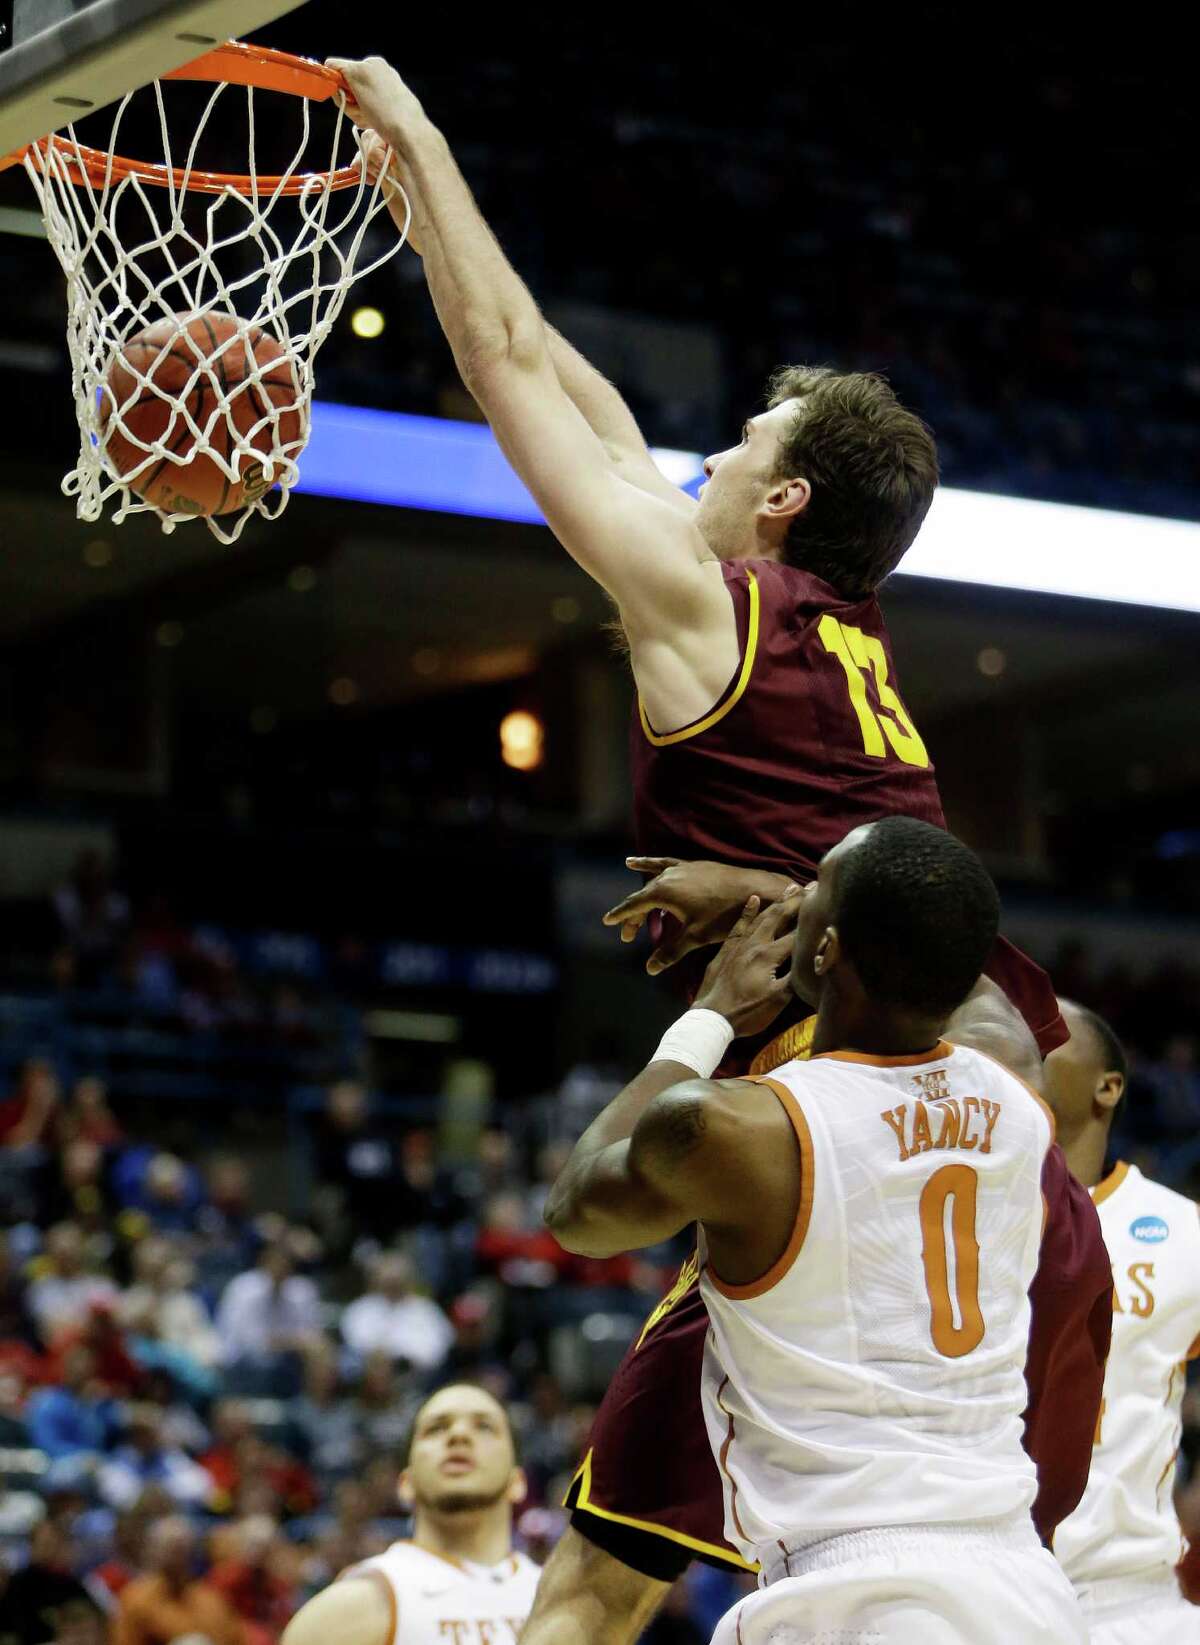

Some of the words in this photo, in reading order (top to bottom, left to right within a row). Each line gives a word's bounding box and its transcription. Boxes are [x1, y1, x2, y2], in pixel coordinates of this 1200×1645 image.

[817, 614, 929, 768] 13
[880, 1096, 1001, 1162] YANCY
[919, 1163, 986, 1358] 0
